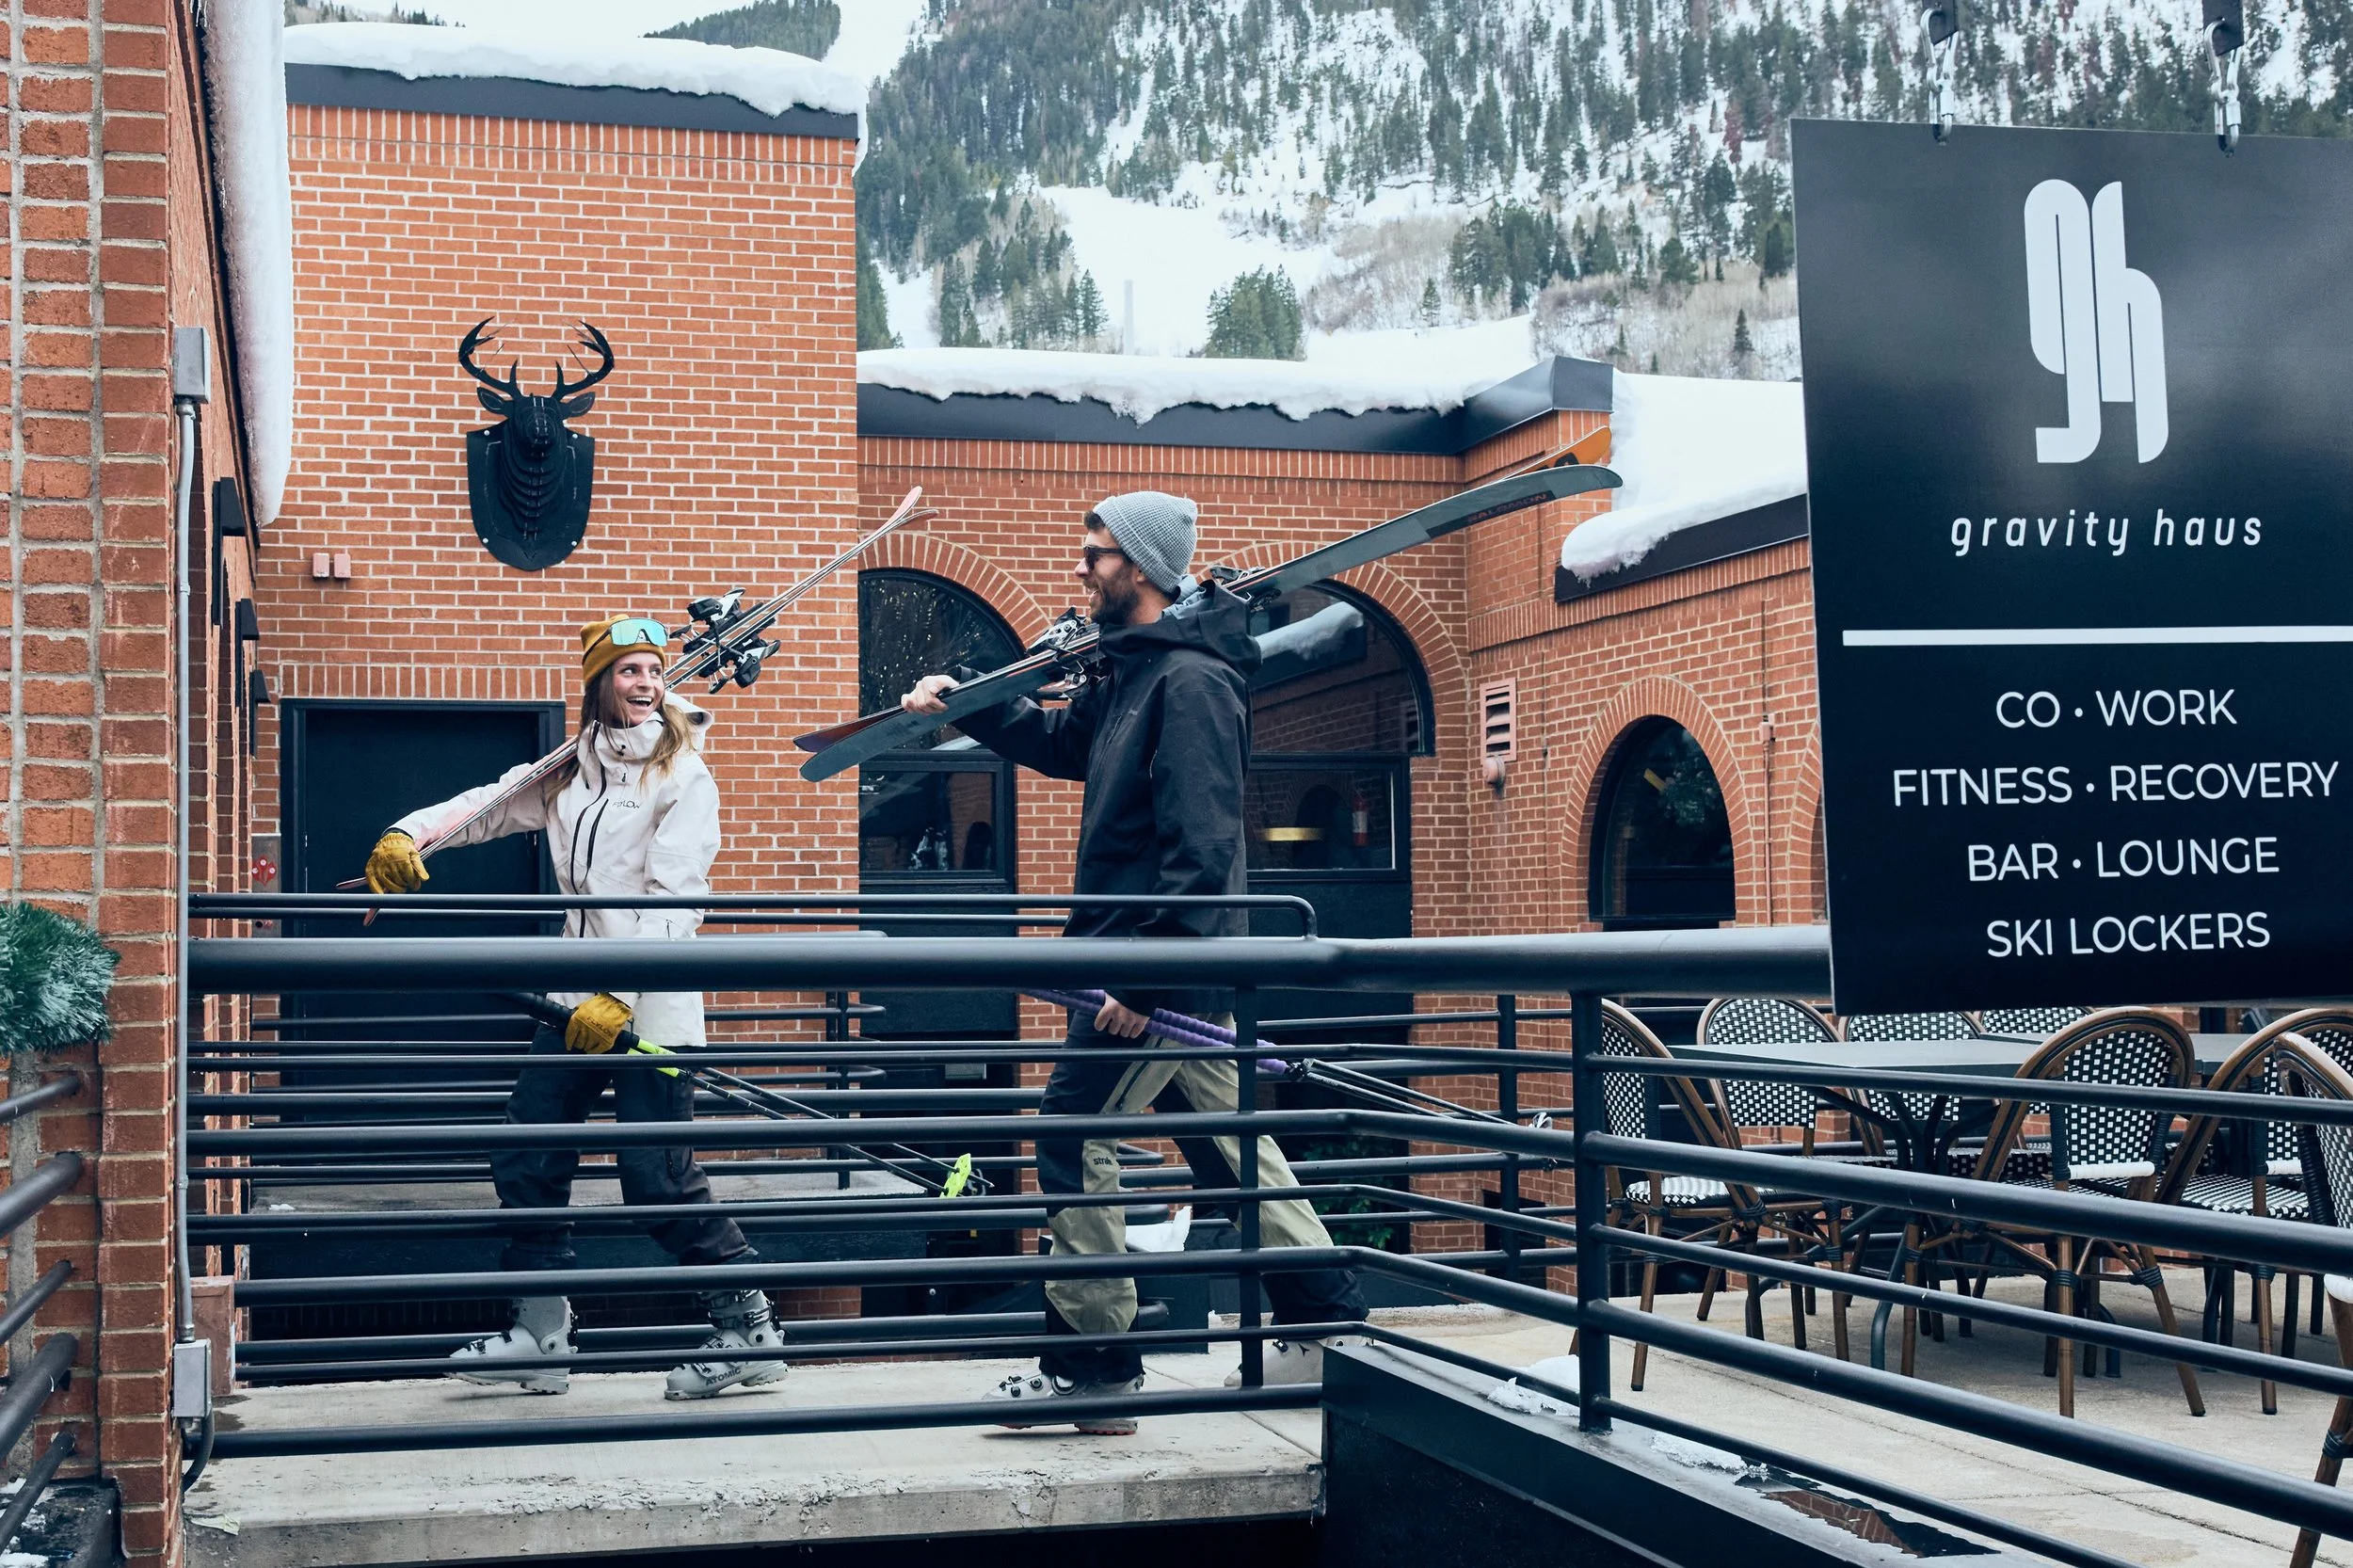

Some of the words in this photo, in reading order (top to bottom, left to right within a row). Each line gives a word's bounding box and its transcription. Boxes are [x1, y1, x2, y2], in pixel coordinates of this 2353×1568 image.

[1466, 492, 1547, 522] SALOMON
[1951, 509, 2128, 556] gravity
[2154, 509, 2261, 546] haus
[1996, 691, 2059, 728] CO
[2096, 690, 2237, 726] WORK
[1894, 766, 2073, 806] FITNESS
[2111, 761, 2338, 801] RECOVERY
[1968, 843, 2059, 881] BAR
[2097, 838, 2279, 877] LOUNGE
[1988, 919, 2053, 956] SKI
[2071, 912, 2270, 954] LOCKERS
[705, 1368, 742, 1386] ATOMIC
